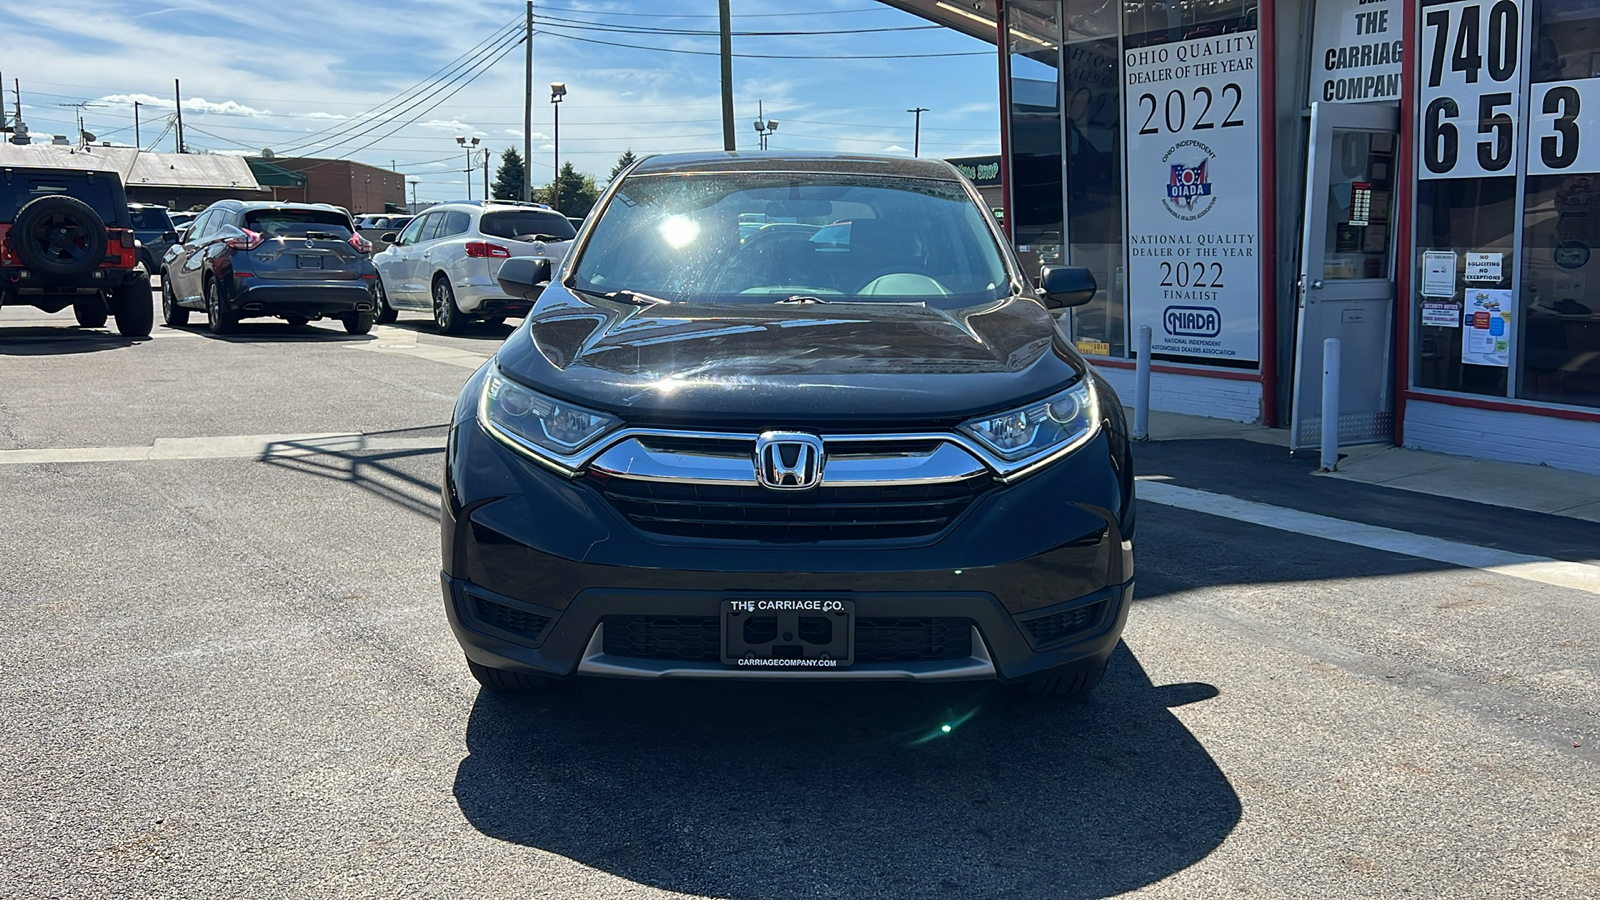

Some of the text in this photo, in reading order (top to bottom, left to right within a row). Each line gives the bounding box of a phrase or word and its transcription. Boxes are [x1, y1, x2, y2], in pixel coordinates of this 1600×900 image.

[1355, 9, 1388, 35] THE
[1127, 35, 1256, 67] OHIO QUALITY
[1426, 0, 1518, 88] 740
[1129, 68, 1172, 85] DEALER
[1175, 65, 1191, 79] OF
[1193, 62, 1218, 76] THE
[1221, 57, 1254, 73] YEAR
[1323, 73, 1402, 102] COMPAN
[1138, 82, 1244, 135] 2022
[1162, 140, 1216, 163] OHIO INDEPENDENT
[977, 162, 999, 180] SHOP
[1172, 184, 1204, 197] OIADA
[1131, 234, 1255, 246] NATIONAL QUALITY
[1132, 248, 1253, 257] DEALER OF THE YEAR
[1160, 261, 1224, 288] 2022
[1164, 290, 1218, 300] FINALIST
[1168, 312, 1215, 335] NIADA
[1181, 346, 1201, 354] DEALERS
[1202, 348, 1236, 356] ASSOCIATION
[1188, 338, 1221, 347] INDEPENDENT
[731, 600, 845, 611] THE CARRIAGE CO.
[738, 659, 837, 667] CARRIAGECOMPANY.COM
